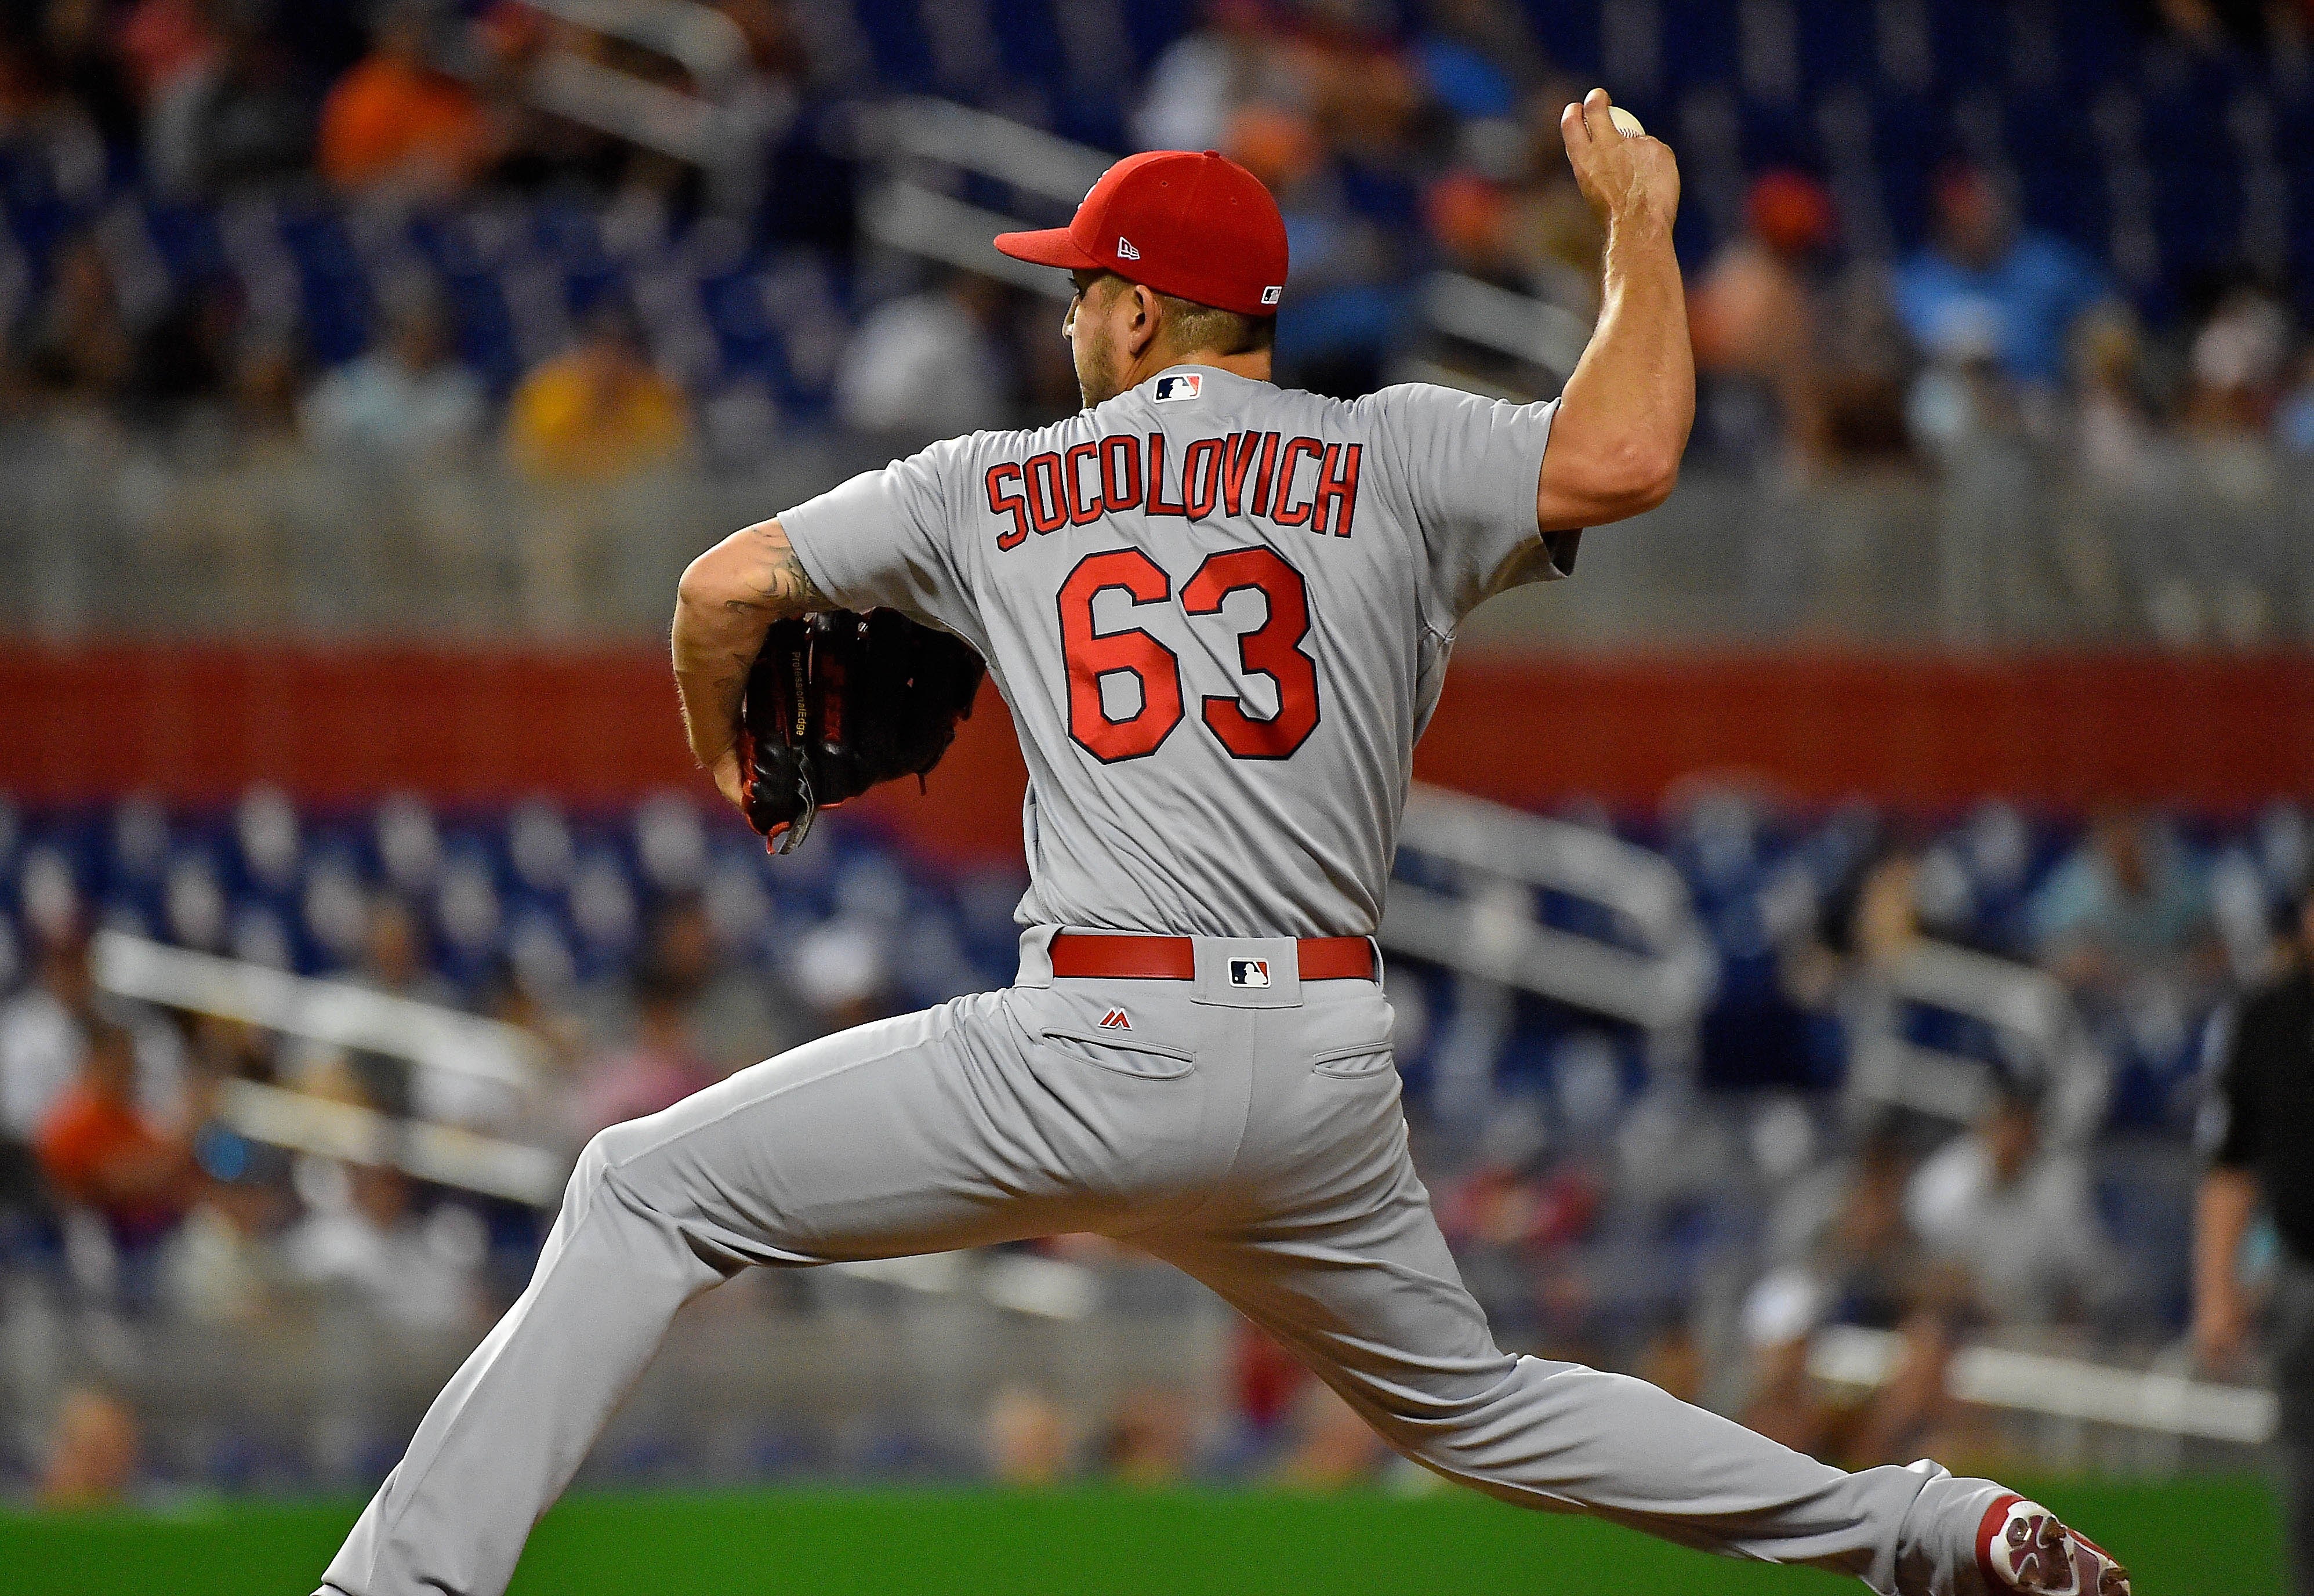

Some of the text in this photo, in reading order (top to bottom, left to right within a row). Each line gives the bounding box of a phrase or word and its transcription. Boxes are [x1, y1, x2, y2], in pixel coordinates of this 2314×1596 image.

[986, 430, 1363, 552] SOCOLOVICH
[791, 651, 807, 737] ProfessionalEdge
[1056, 545, 1321, 765] 63
